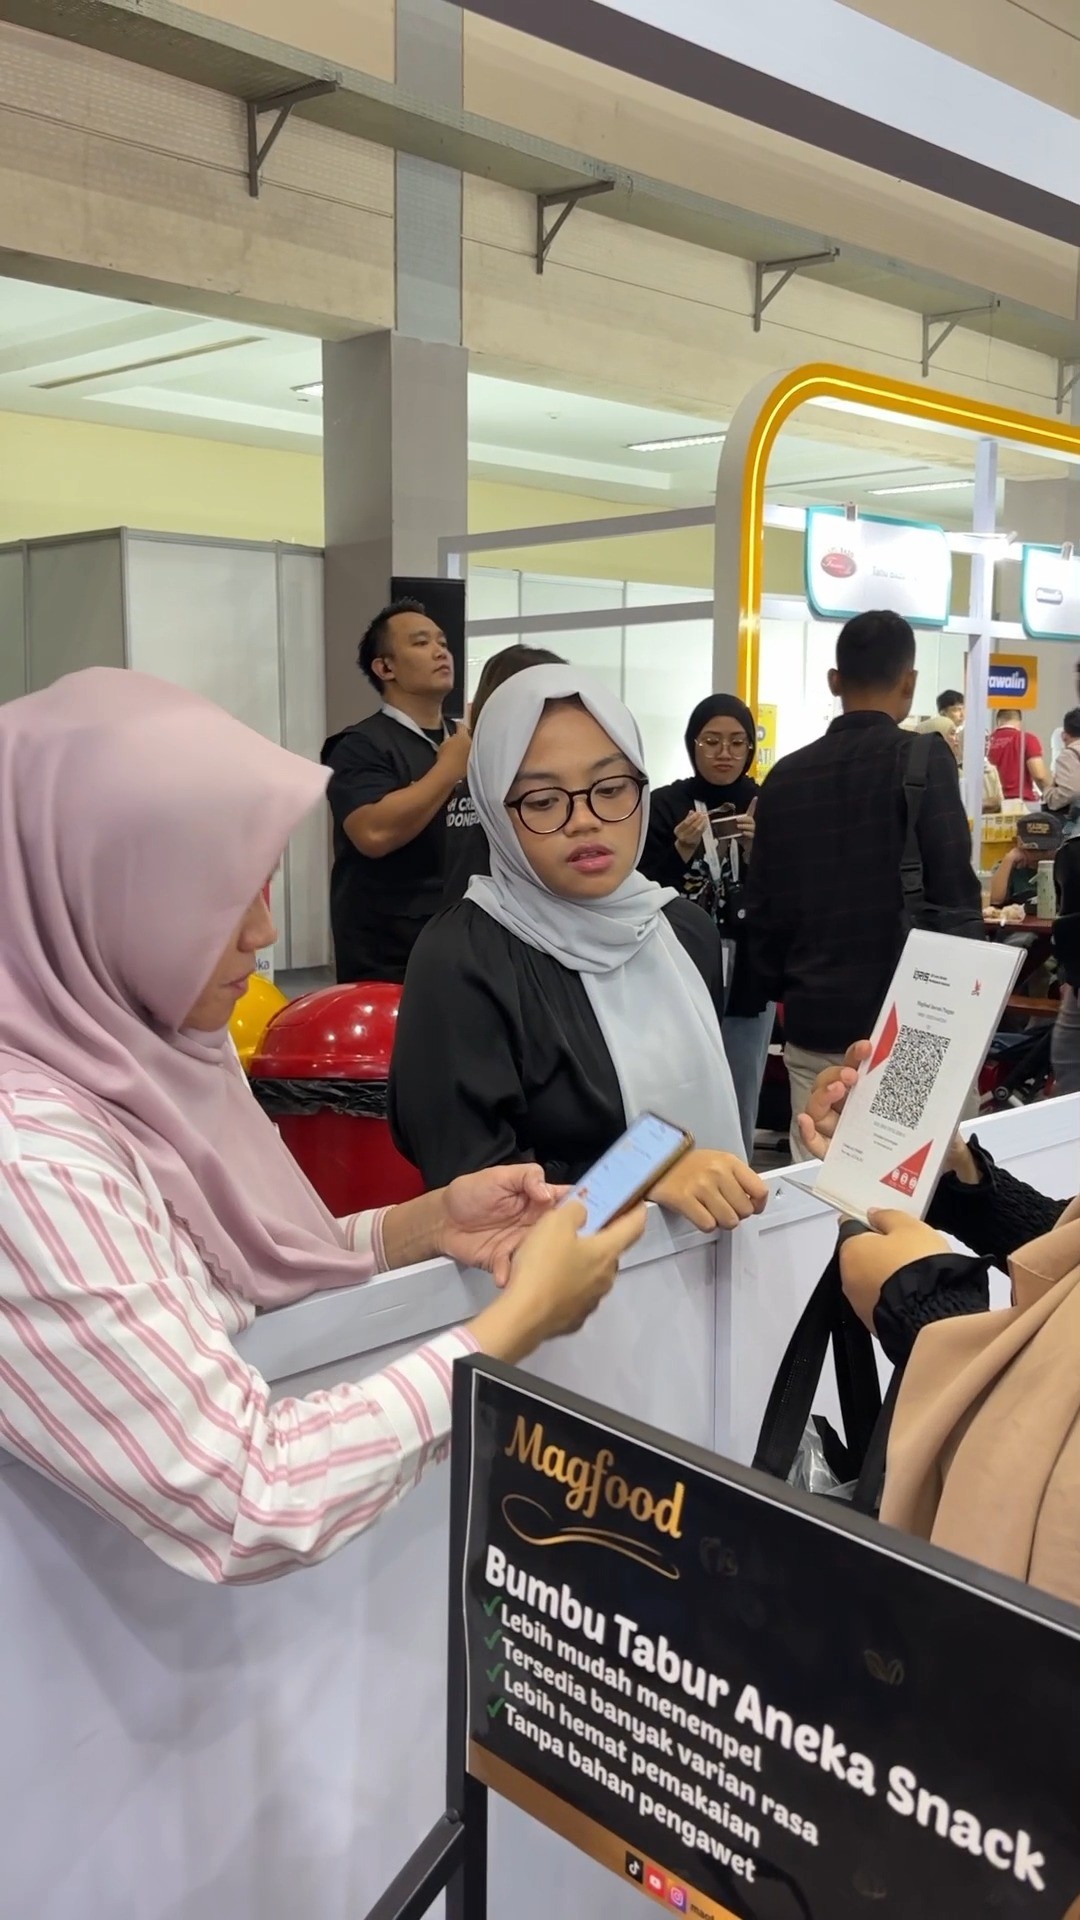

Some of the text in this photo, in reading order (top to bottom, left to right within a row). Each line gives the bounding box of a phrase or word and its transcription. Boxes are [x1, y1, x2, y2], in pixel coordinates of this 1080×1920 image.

[988, 670, 1026, 690] awalin
[255, 958, 270, 970] ka
[504, 1415, 686, 1539] Magfood
[485, 1544, 1045, 1891] Bumbu Tabur Aneka Snack
[501, 1603, 762, 1773] Lebih mudah menempel
[501, 1636, 820, 1847] Tersedia banyak varian rasa
[503, 1669, 761, 1849] Lebih hemat pemakaian
[503, 1702, 757, 1884] Tanpa bahan pengawet
